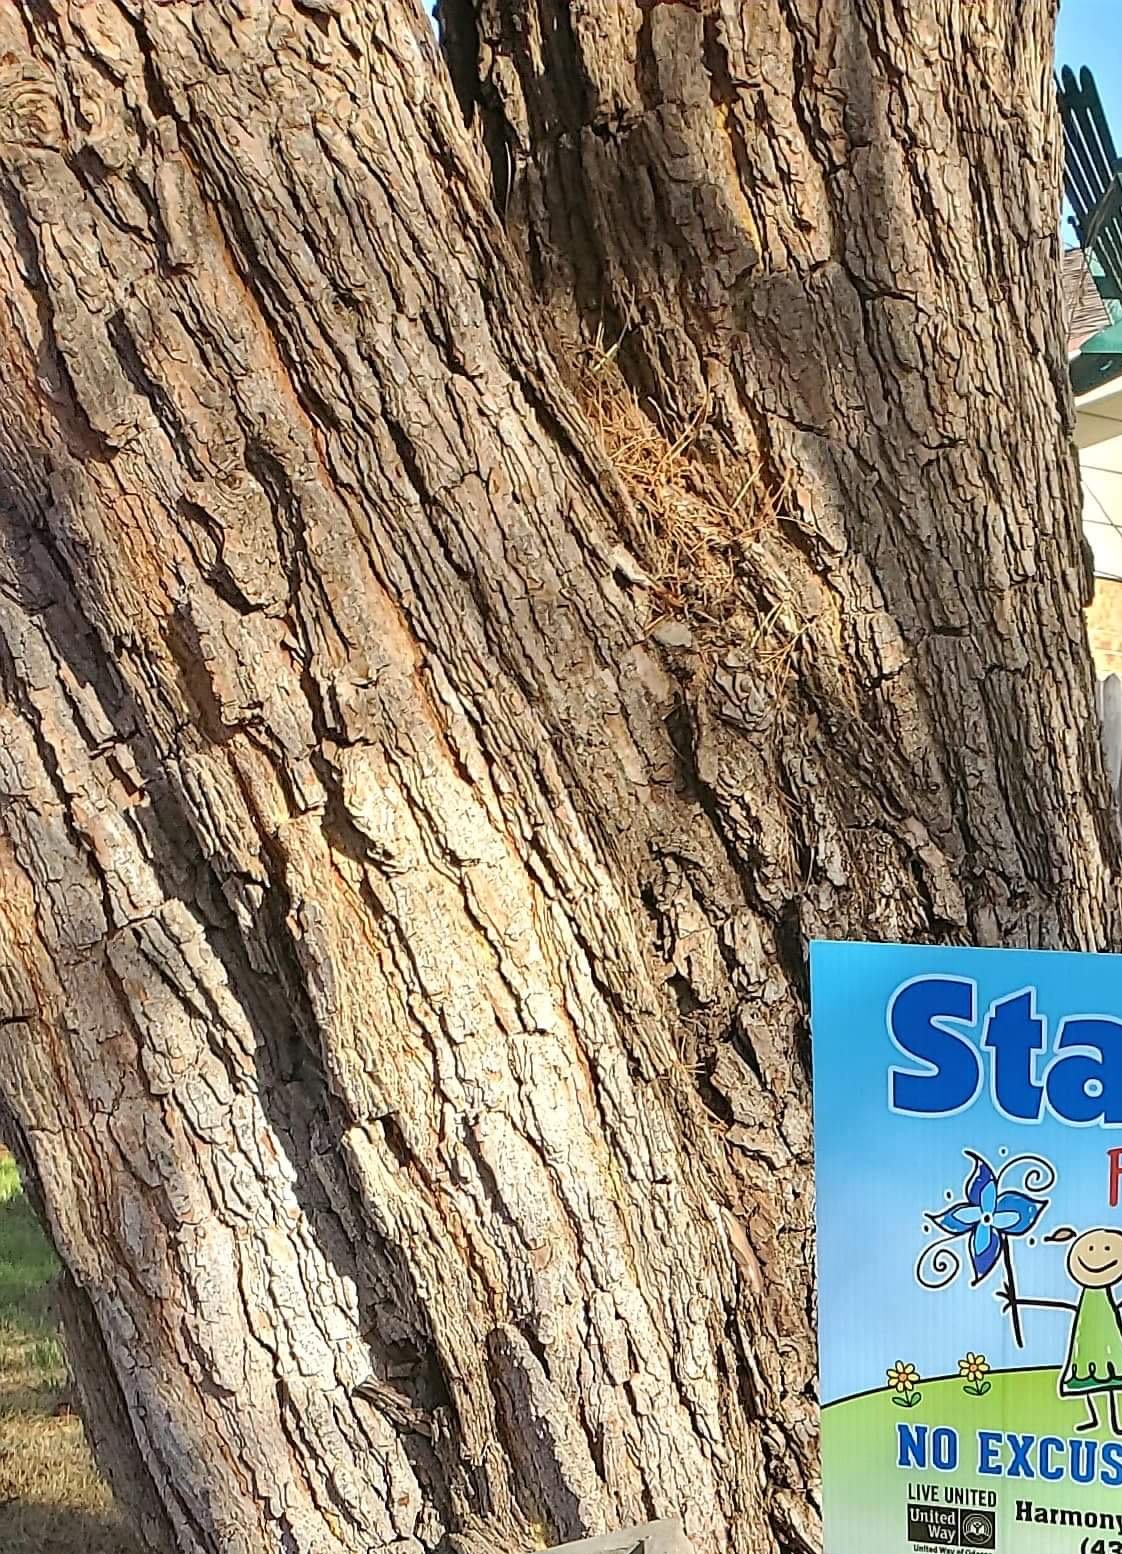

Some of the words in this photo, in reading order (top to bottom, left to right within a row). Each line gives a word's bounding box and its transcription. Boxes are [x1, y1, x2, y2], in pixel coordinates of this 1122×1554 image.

[898, 1424, 958, 1471] NO
[908, 1483, 940, 1502] LIVE
[944, 1486, 997, 1507] UNITED
[910, 1508, 956, 1526] United
[928, 1524, 956, 1543] Way
[913, 1544, 938, 1554] United
